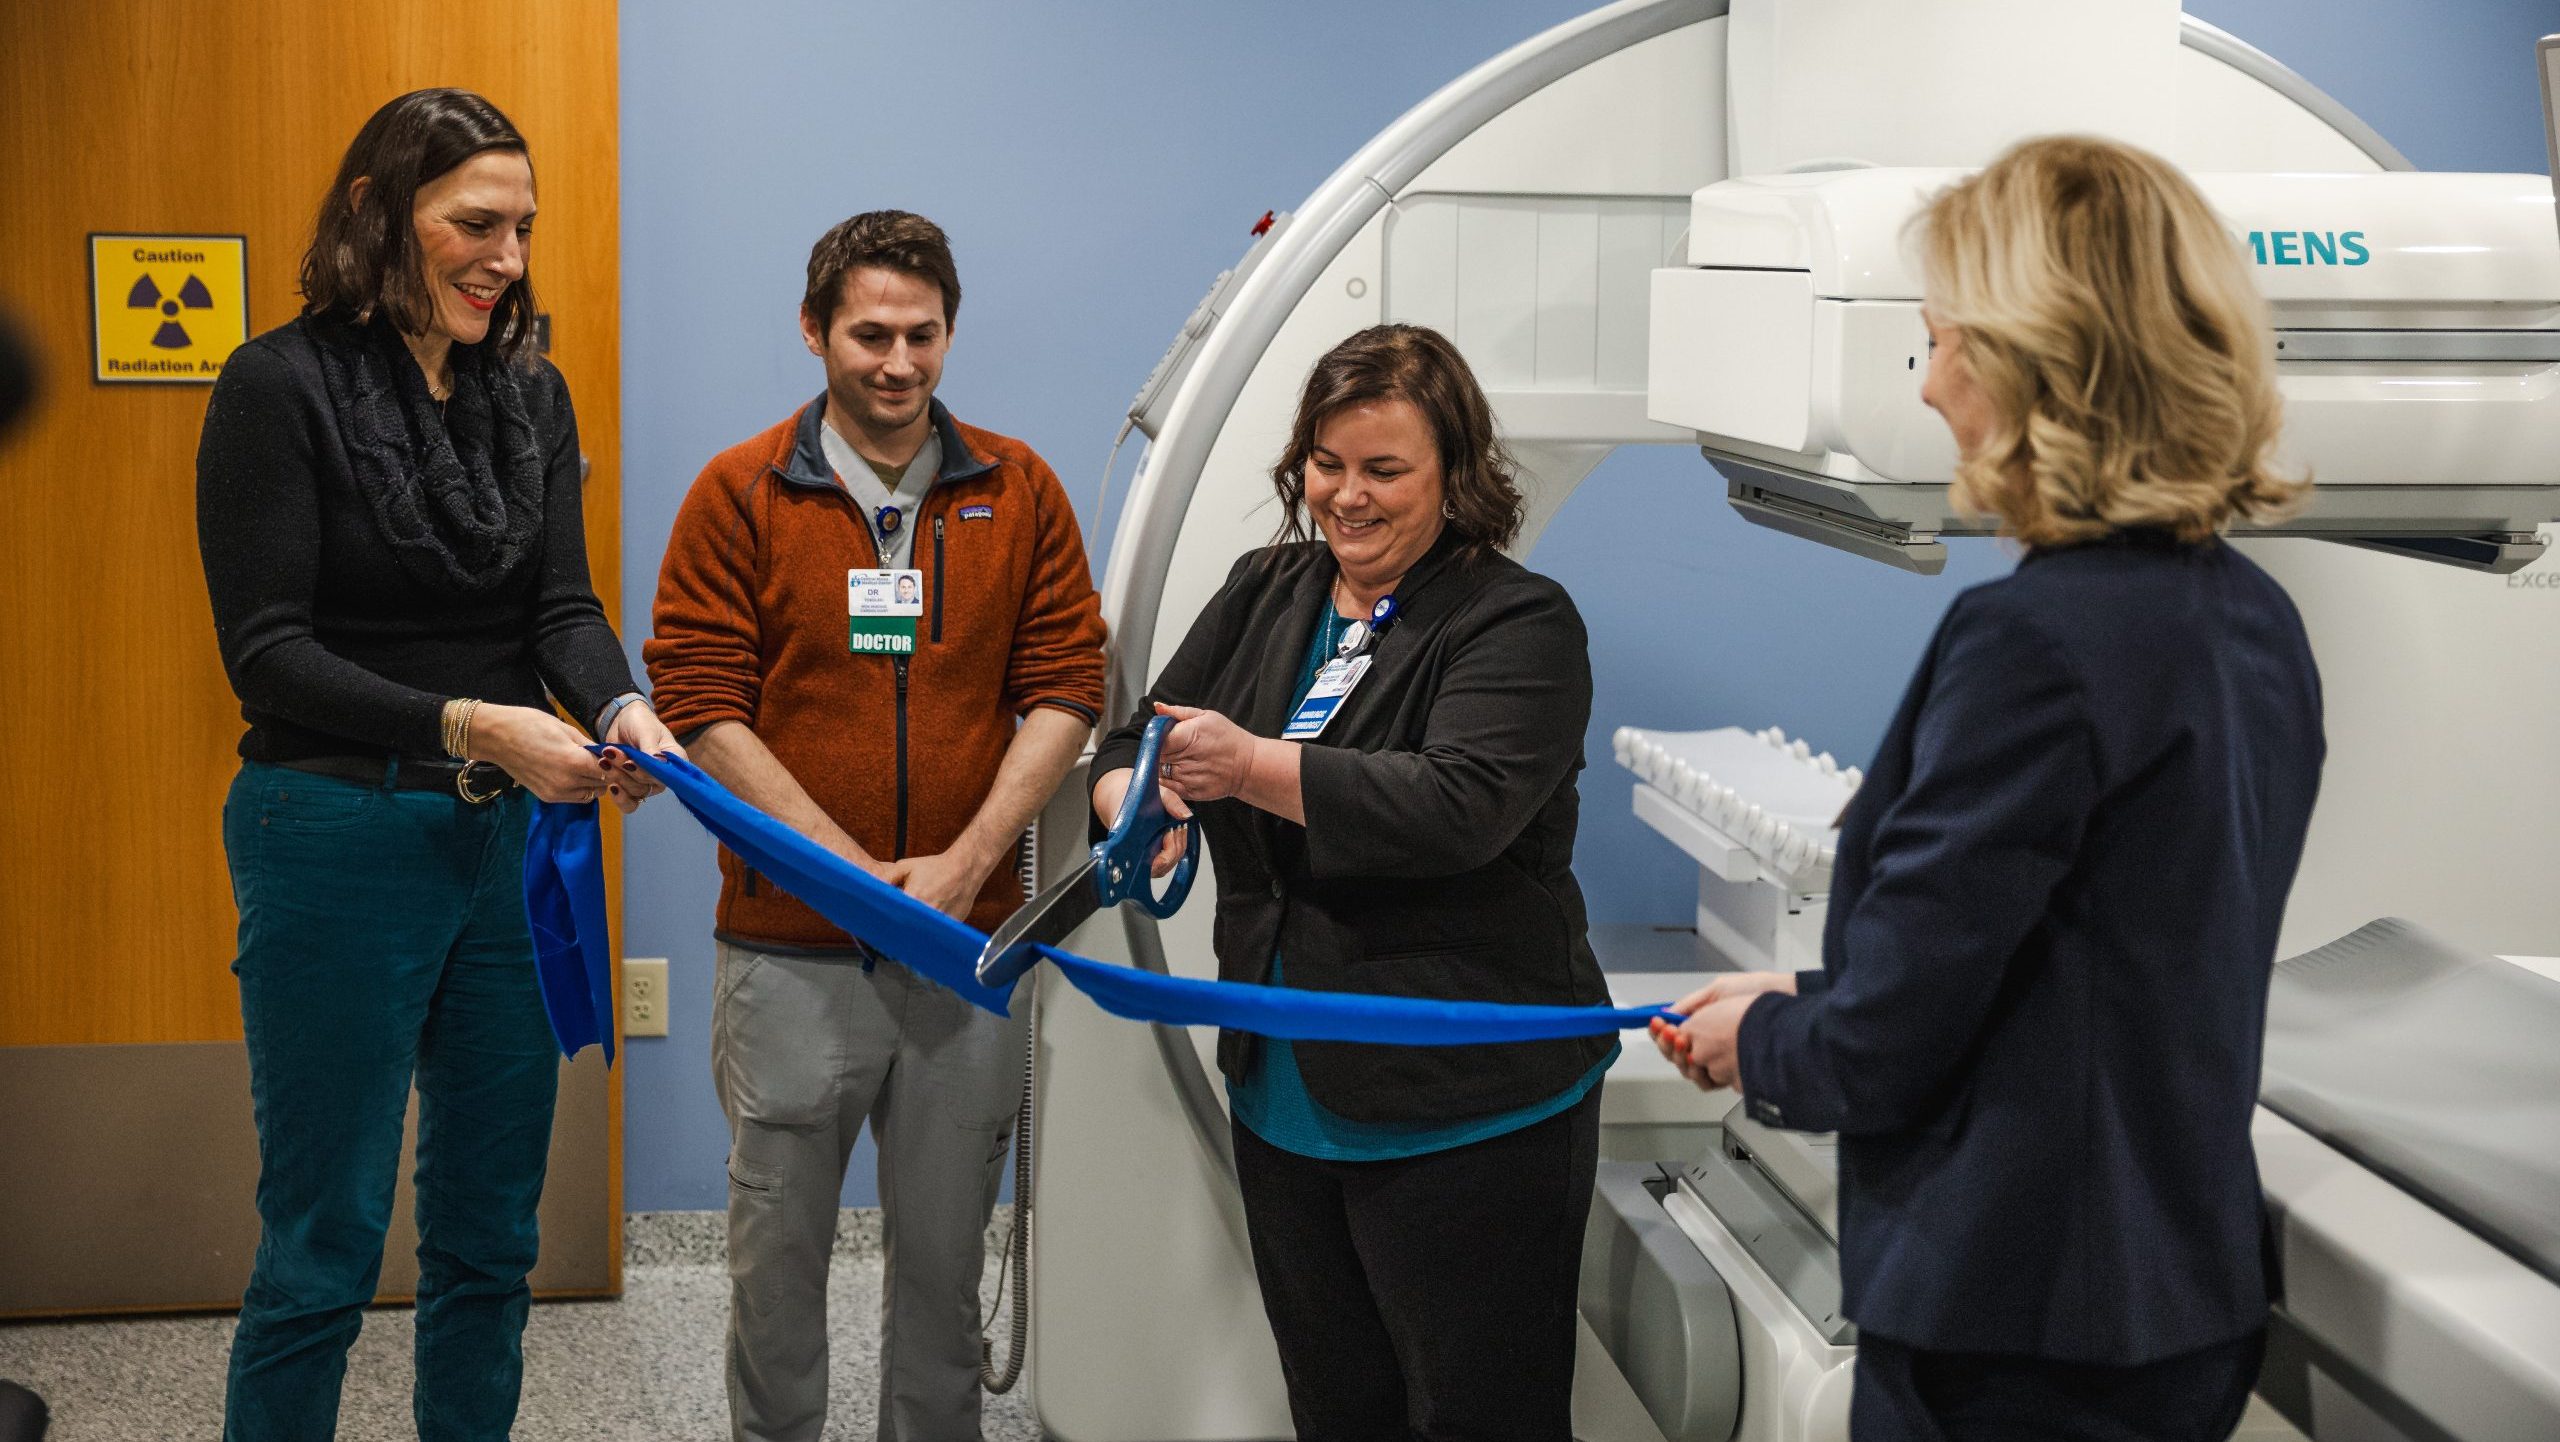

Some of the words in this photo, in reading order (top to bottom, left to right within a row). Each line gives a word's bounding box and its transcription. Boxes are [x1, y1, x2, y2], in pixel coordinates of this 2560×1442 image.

[133, 249, 205, 263] Caution
[108, 359, 194, 372] Radiation
[852, 633, 912, 652] DOCTOR
